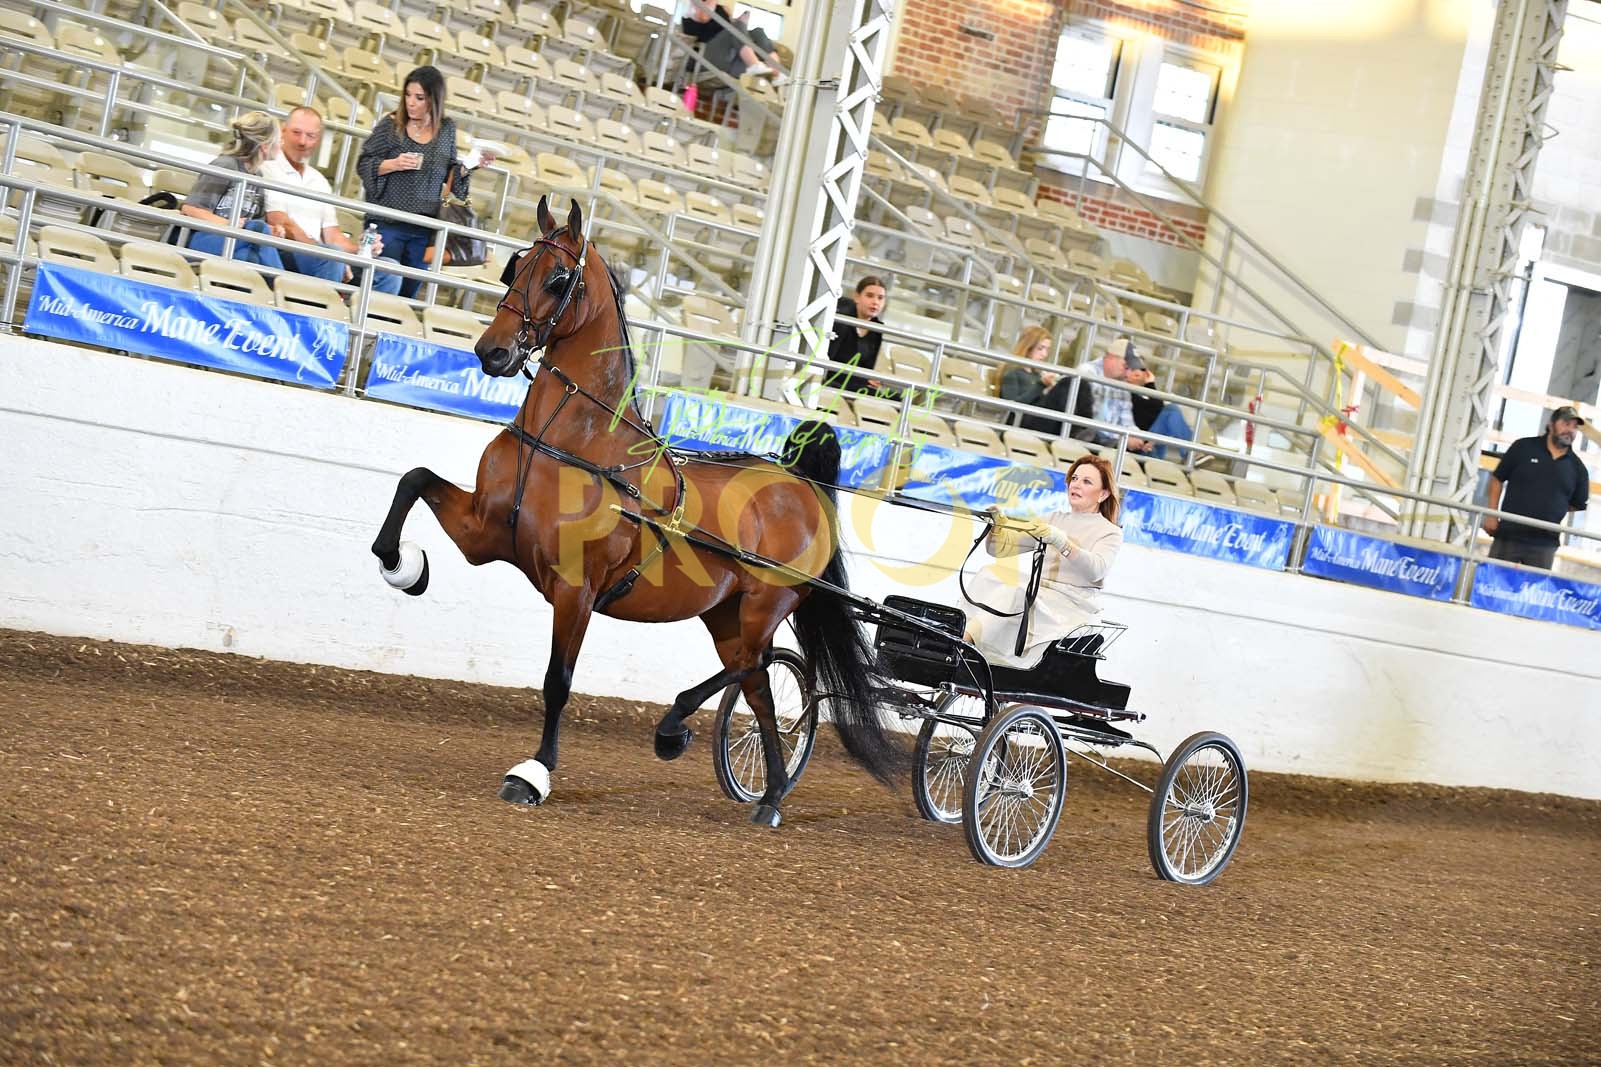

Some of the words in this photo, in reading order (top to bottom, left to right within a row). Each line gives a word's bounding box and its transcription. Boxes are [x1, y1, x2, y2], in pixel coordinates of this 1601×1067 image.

[38, 294, 141, 331] Mid-America
[140, 301, 221, 347] Mane
[222, 317, 302, 363] Event
[375, 359, 461, 395] Mid-America
[460, 367, 526, 407] Man
[1360, 549, 1398, 577] Mane
[1397, 556, 1441, 586] Event
